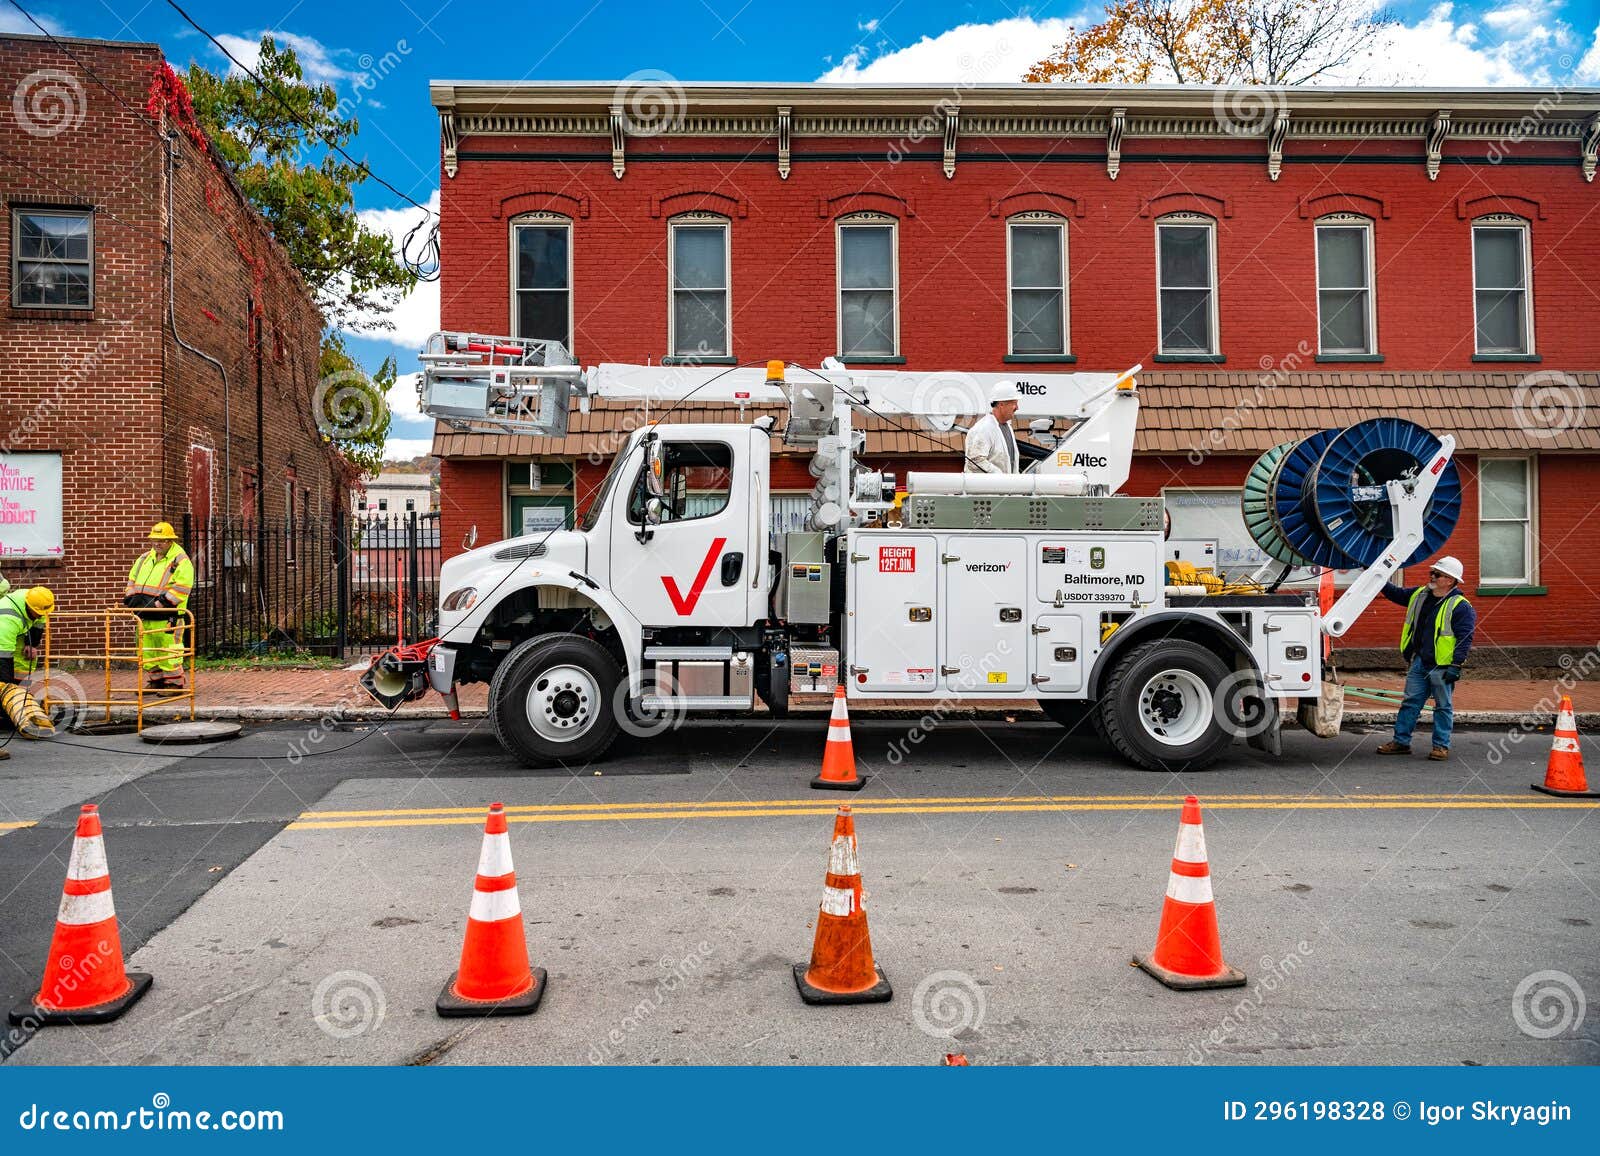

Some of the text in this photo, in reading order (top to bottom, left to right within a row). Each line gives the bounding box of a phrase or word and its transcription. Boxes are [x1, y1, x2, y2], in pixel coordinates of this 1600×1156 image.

[1016, 381, 1047, 396] Altec
[1073, 453, 1107, 468] Altec
[882, 548, 913, 558] HEIGHT
[966, 562, 1006, 573] verizon
[1064, 573, 1145, 587] Baltimore, MD
[1064, 593, 1125, 601] USDOT 339370
